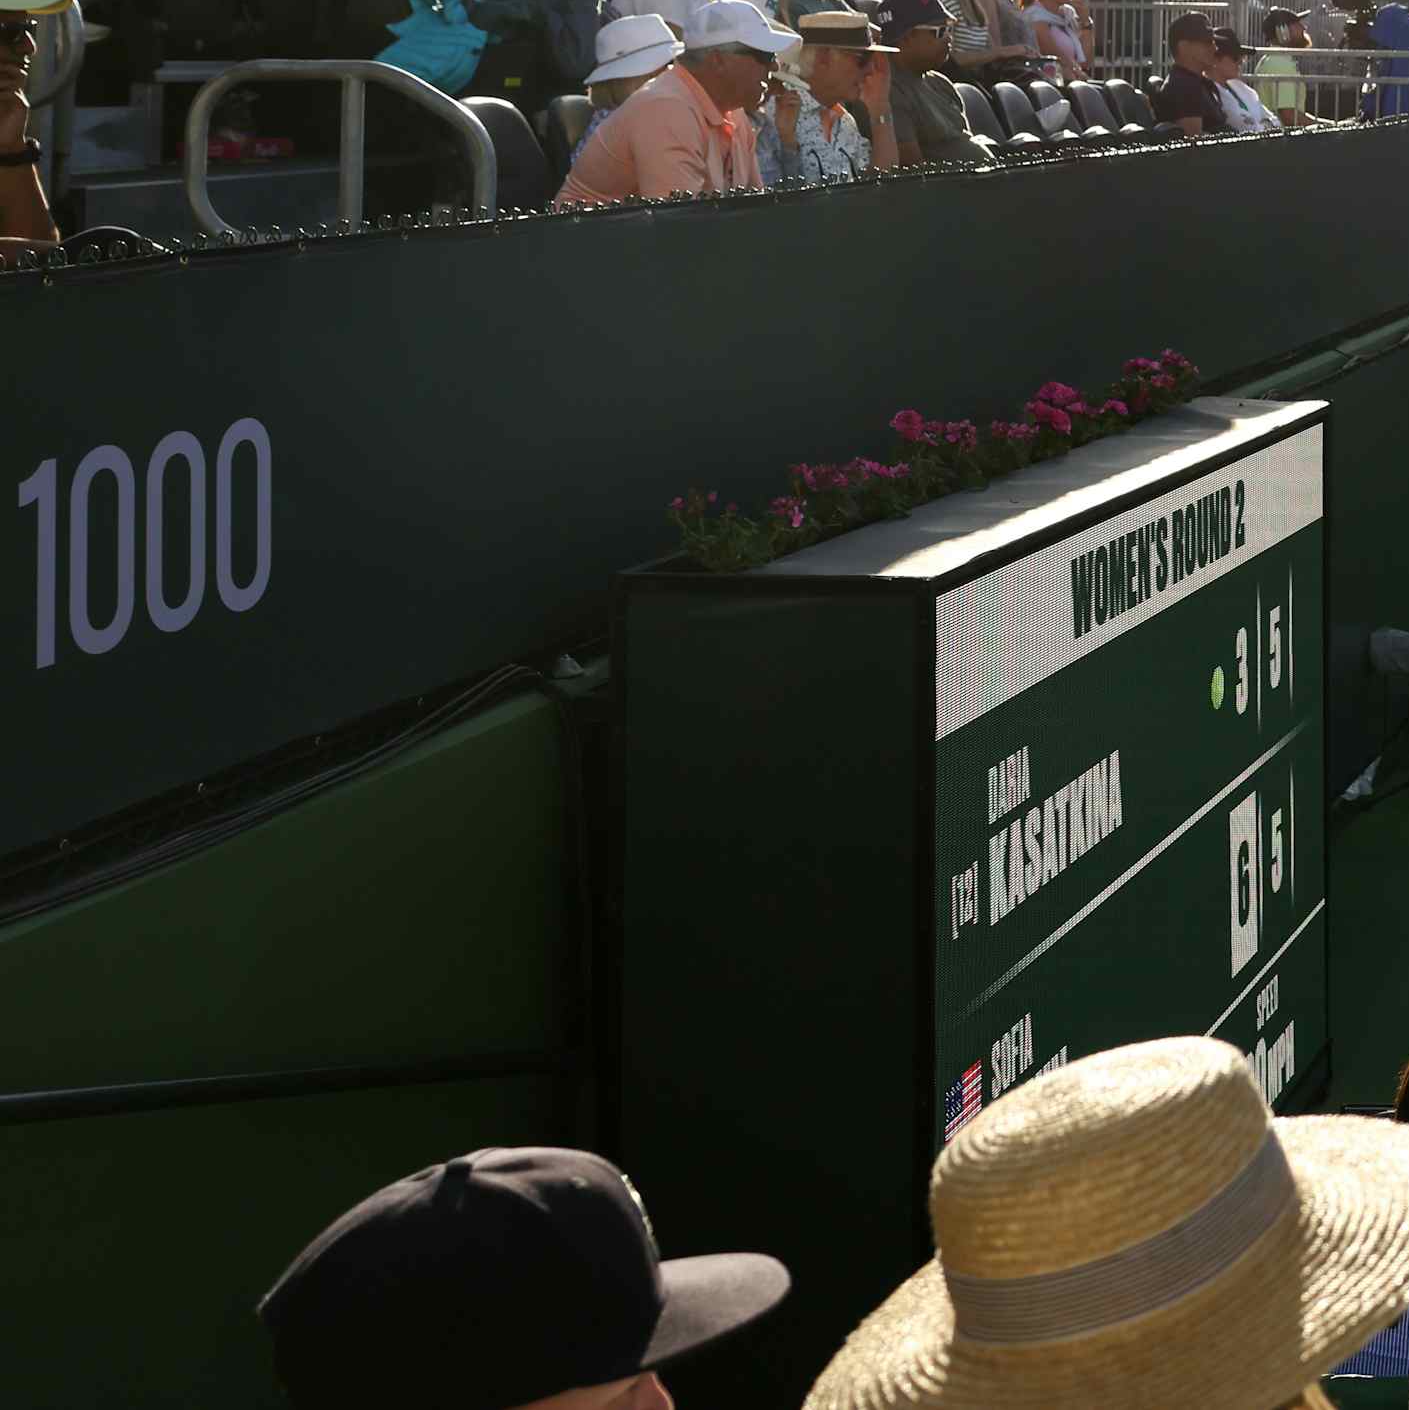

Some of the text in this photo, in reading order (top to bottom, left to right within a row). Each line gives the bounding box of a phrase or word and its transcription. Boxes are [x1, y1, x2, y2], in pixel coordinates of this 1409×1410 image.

[18, 417, 271, 669] 1000
[1071, 479, 1246, 640] WOMEN'S ROUND 2
[1236, 605, 1281, 715] 3 5
[988, 745, 1030, 825] DARIA
[988, 749, 1123, 926] KASATKINA
[1237, 808, 1282, 928] 6 5
[991, 1012, 1033, 1100] SOFIA
